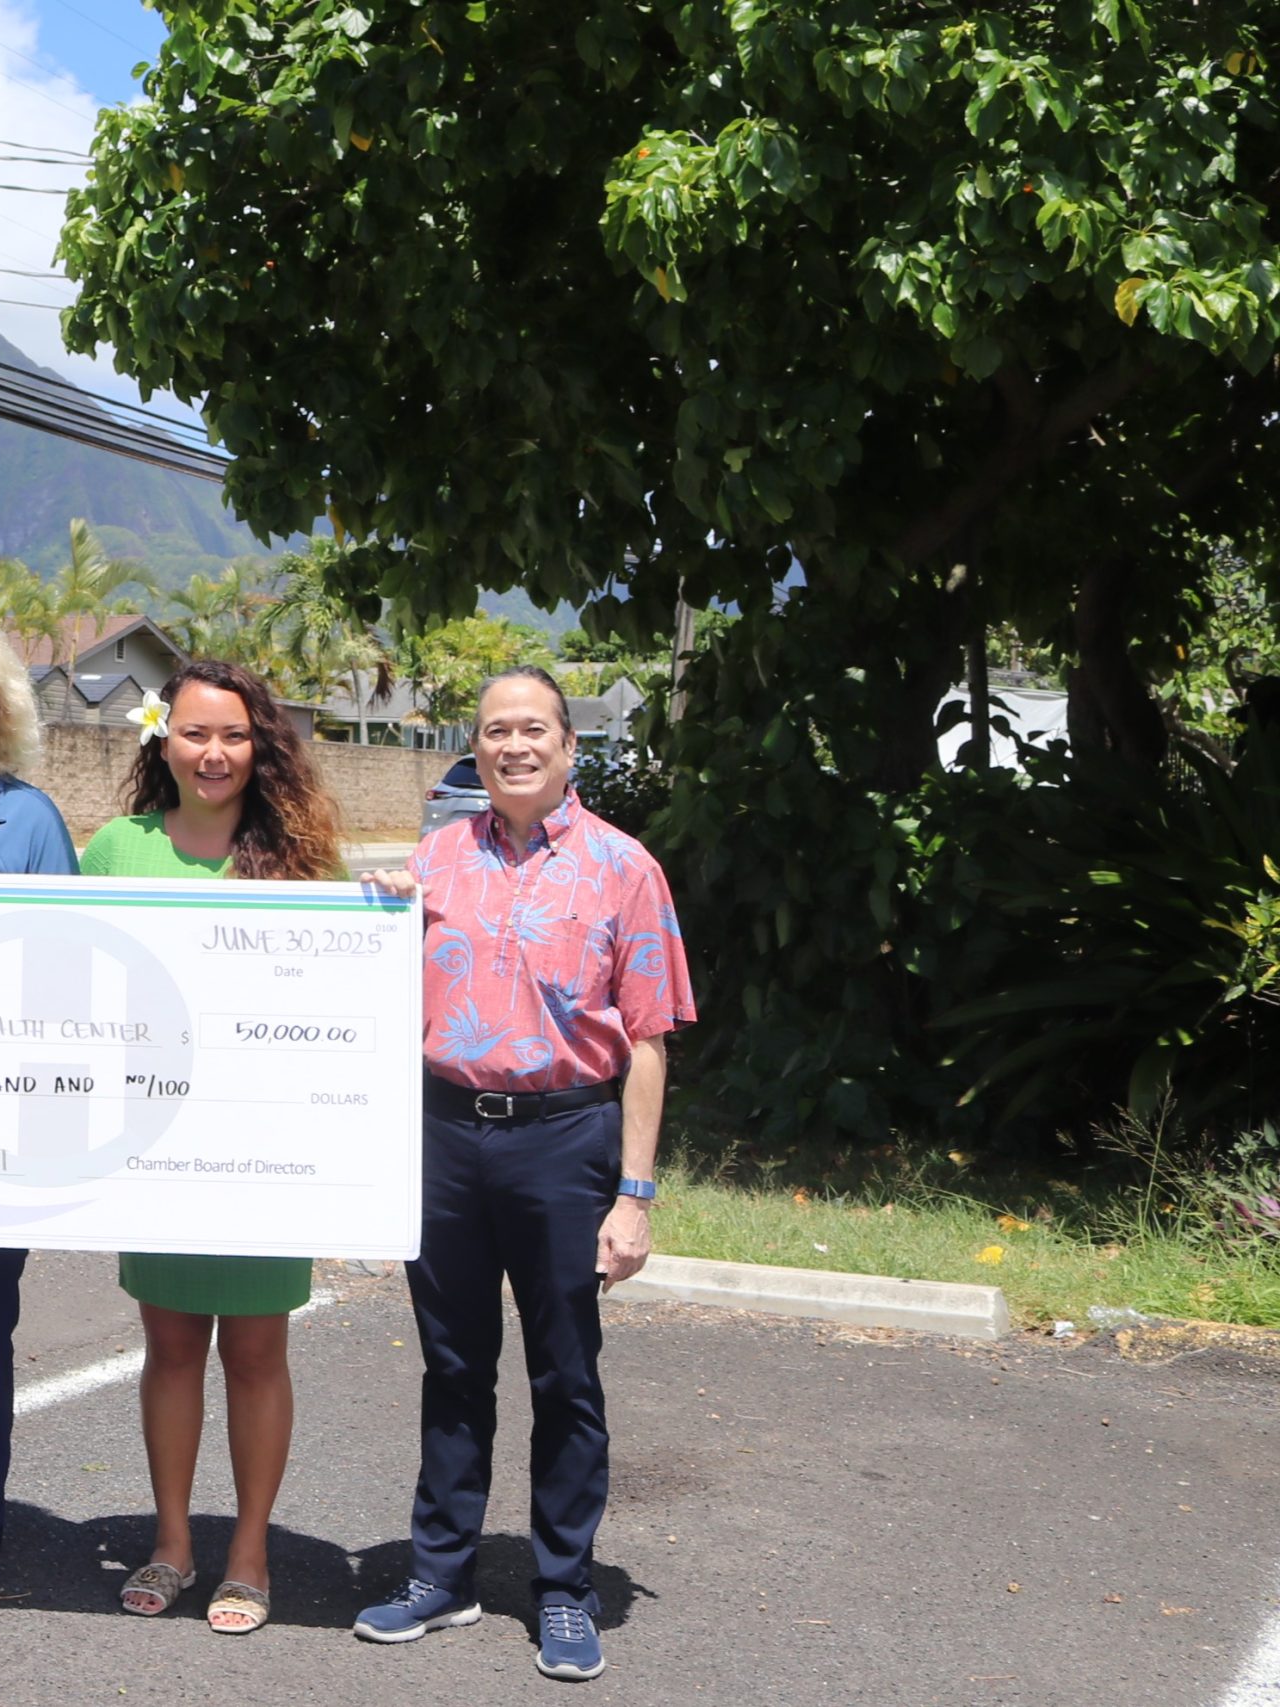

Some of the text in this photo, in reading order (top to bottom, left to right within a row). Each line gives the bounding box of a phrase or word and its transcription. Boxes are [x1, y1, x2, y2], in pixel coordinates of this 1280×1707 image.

[375, 923, 397, 933] 0100
[201, 924, 280, 954] JUNE
[274, 965, 304, 978] Date
[60, 1018, 152, 1043] CENTER
[180, 1031, 190, 1046] $
[54, 1076, 95, 1094] AND
[310, 1092, 369, 1106] DOLLARS
[126, 1156, 316, 1176] Chamber Board of Directors
